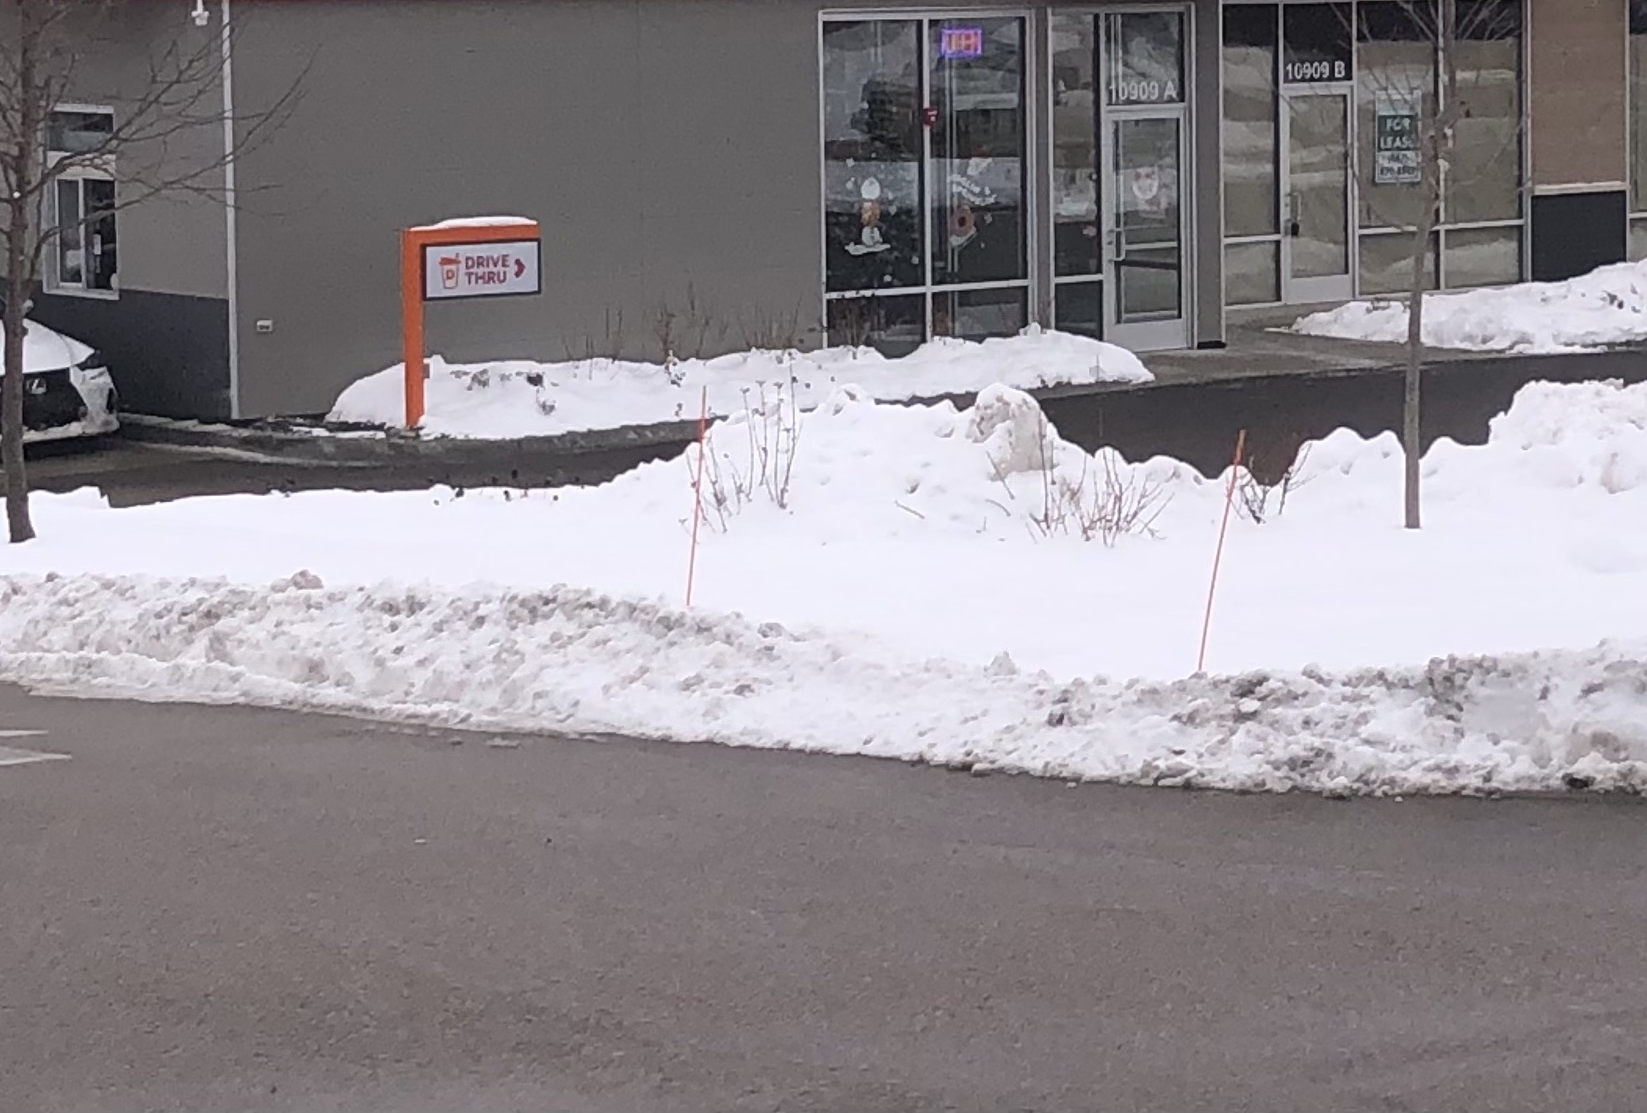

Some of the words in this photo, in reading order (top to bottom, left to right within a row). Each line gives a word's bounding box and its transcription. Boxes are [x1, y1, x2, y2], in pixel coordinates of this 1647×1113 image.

[1286, 61, 1329, 80] 10909
[1334, 60, 1346, 78] B
[1109, 81, 1159, 104] 10909
[1163, 79, 1178, 101] A
[1386, 117, 1411, 132] FOR
[465, 253, 510, 270] DRIVE
[465, 270, 508, 286] THRU
